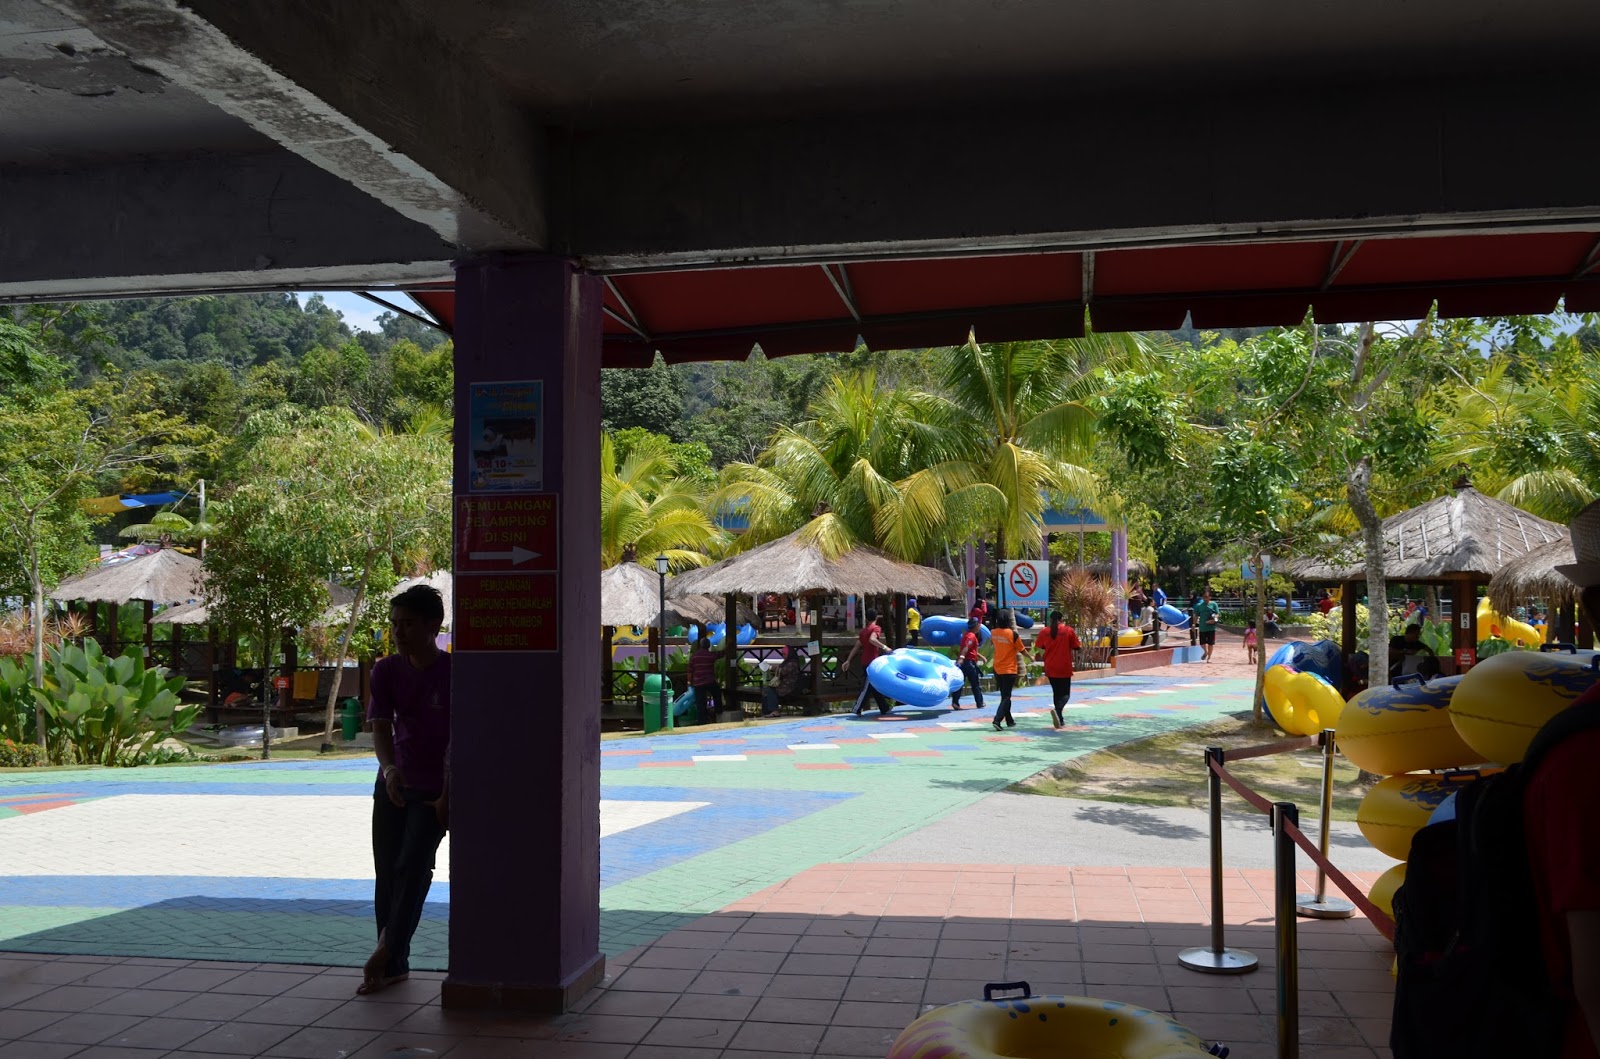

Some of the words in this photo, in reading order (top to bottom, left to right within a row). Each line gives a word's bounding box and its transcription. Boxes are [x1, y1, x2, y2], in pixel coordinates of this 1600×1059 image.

[495, 460, 506, 468] 10
[461, 499, 552, 512] PEMULANGAN
[466, 515, 547, 527] PELAMPUNG
[485, 532, 497, 543] DI
[501, 531, 528, 543] SINI
[480, 578, 531, 592] PEMULANGAN
[459, 598, 506, 610] PELAMPUNG
[507, 597, 552, 609] HENDAKLAH
[469, 615, 508, 628] MENGIKUT
[509, 615, 543, 628] NOMBOR
[483, 634, 503, 646] YANG
[504, 634, 528, 646] BETUL
